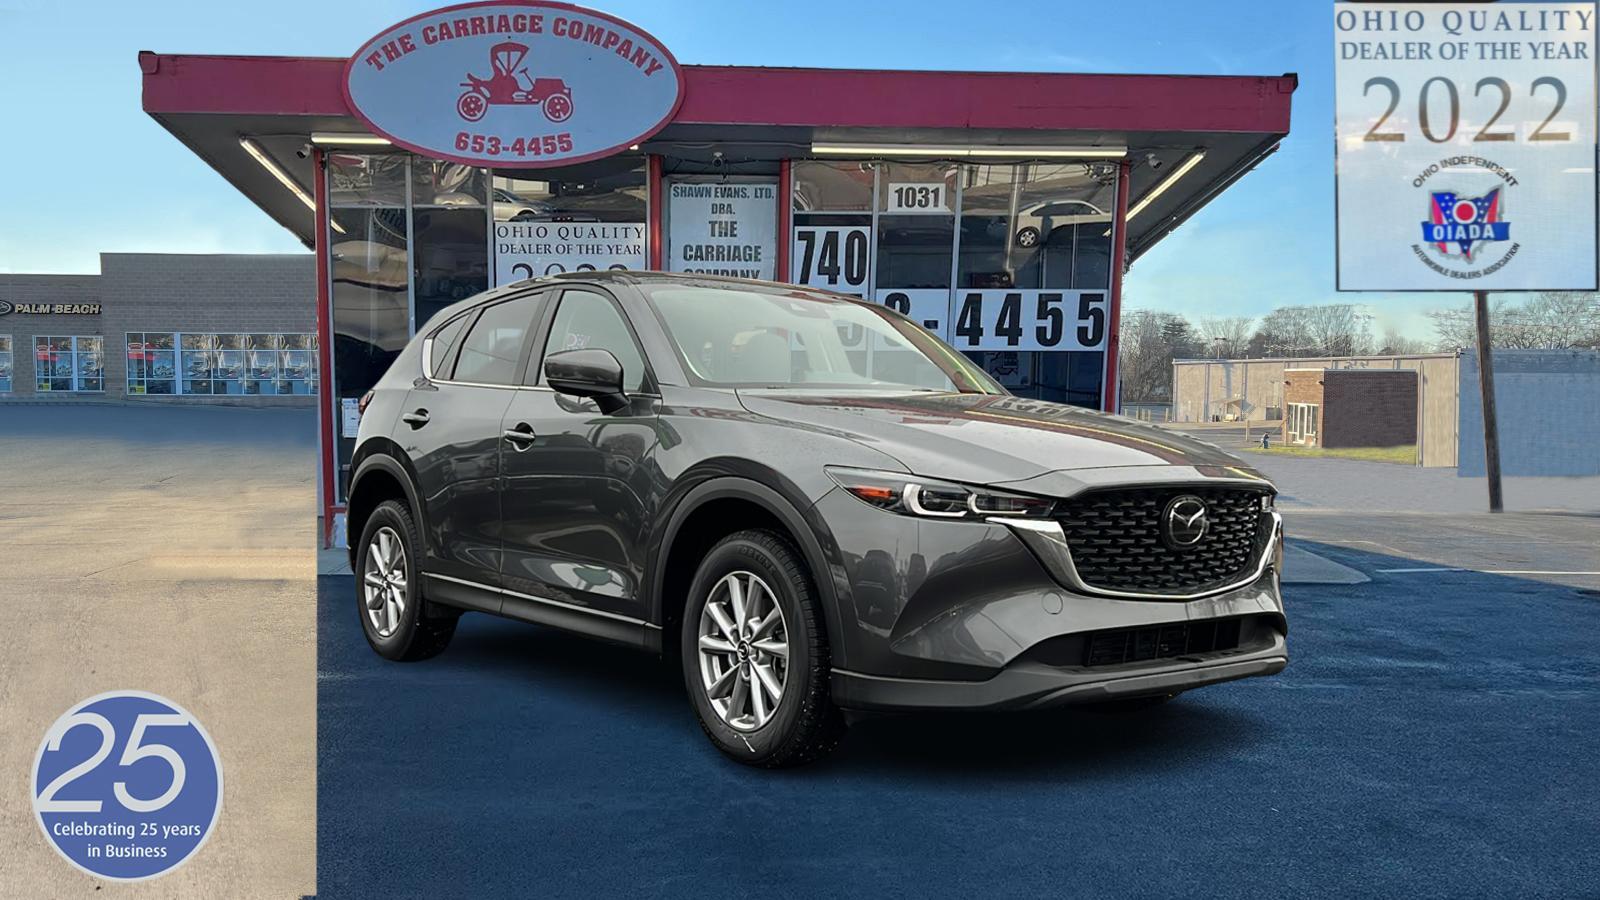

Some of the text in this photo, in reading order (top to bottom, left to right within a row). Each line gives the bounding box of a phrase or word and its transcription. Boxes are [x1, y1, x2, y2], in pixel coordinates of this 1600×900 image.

[1336, 10, 1593, 35] OHIO QUALITY
[365, 14, 664, 77] THE CARRIAGE COMPANY
[1340, 41, 1589, 60] DEALER OF THE YEAR
[1361, 76, 1571, 143] 2022
[454, 131, 574, 157] 653-4455
[1412, 155, 1519, 188] OHIO INDEPENDENT
[672, 185, 712, 199] SHAWN
[754, 187, 775, 200] LTD.
[893, 186, 941, 208] 1031
[711, 203, 736, 215] DBA.
[497, 226, 643, 241] OHIO QUALITY
[708, 220, 738, 238] THE
[1432, 224, 1495, 240] OIADA
[499, 244, 641, 255] DEALER OF THE YEAR
[683, 244, 762, 262] CARRIAGE
[797, 230, 868, 286] 740
[1411, 243, 1450, 276] AUTOMOBILE
[1449, 269, 1482, 280] DEALERS
